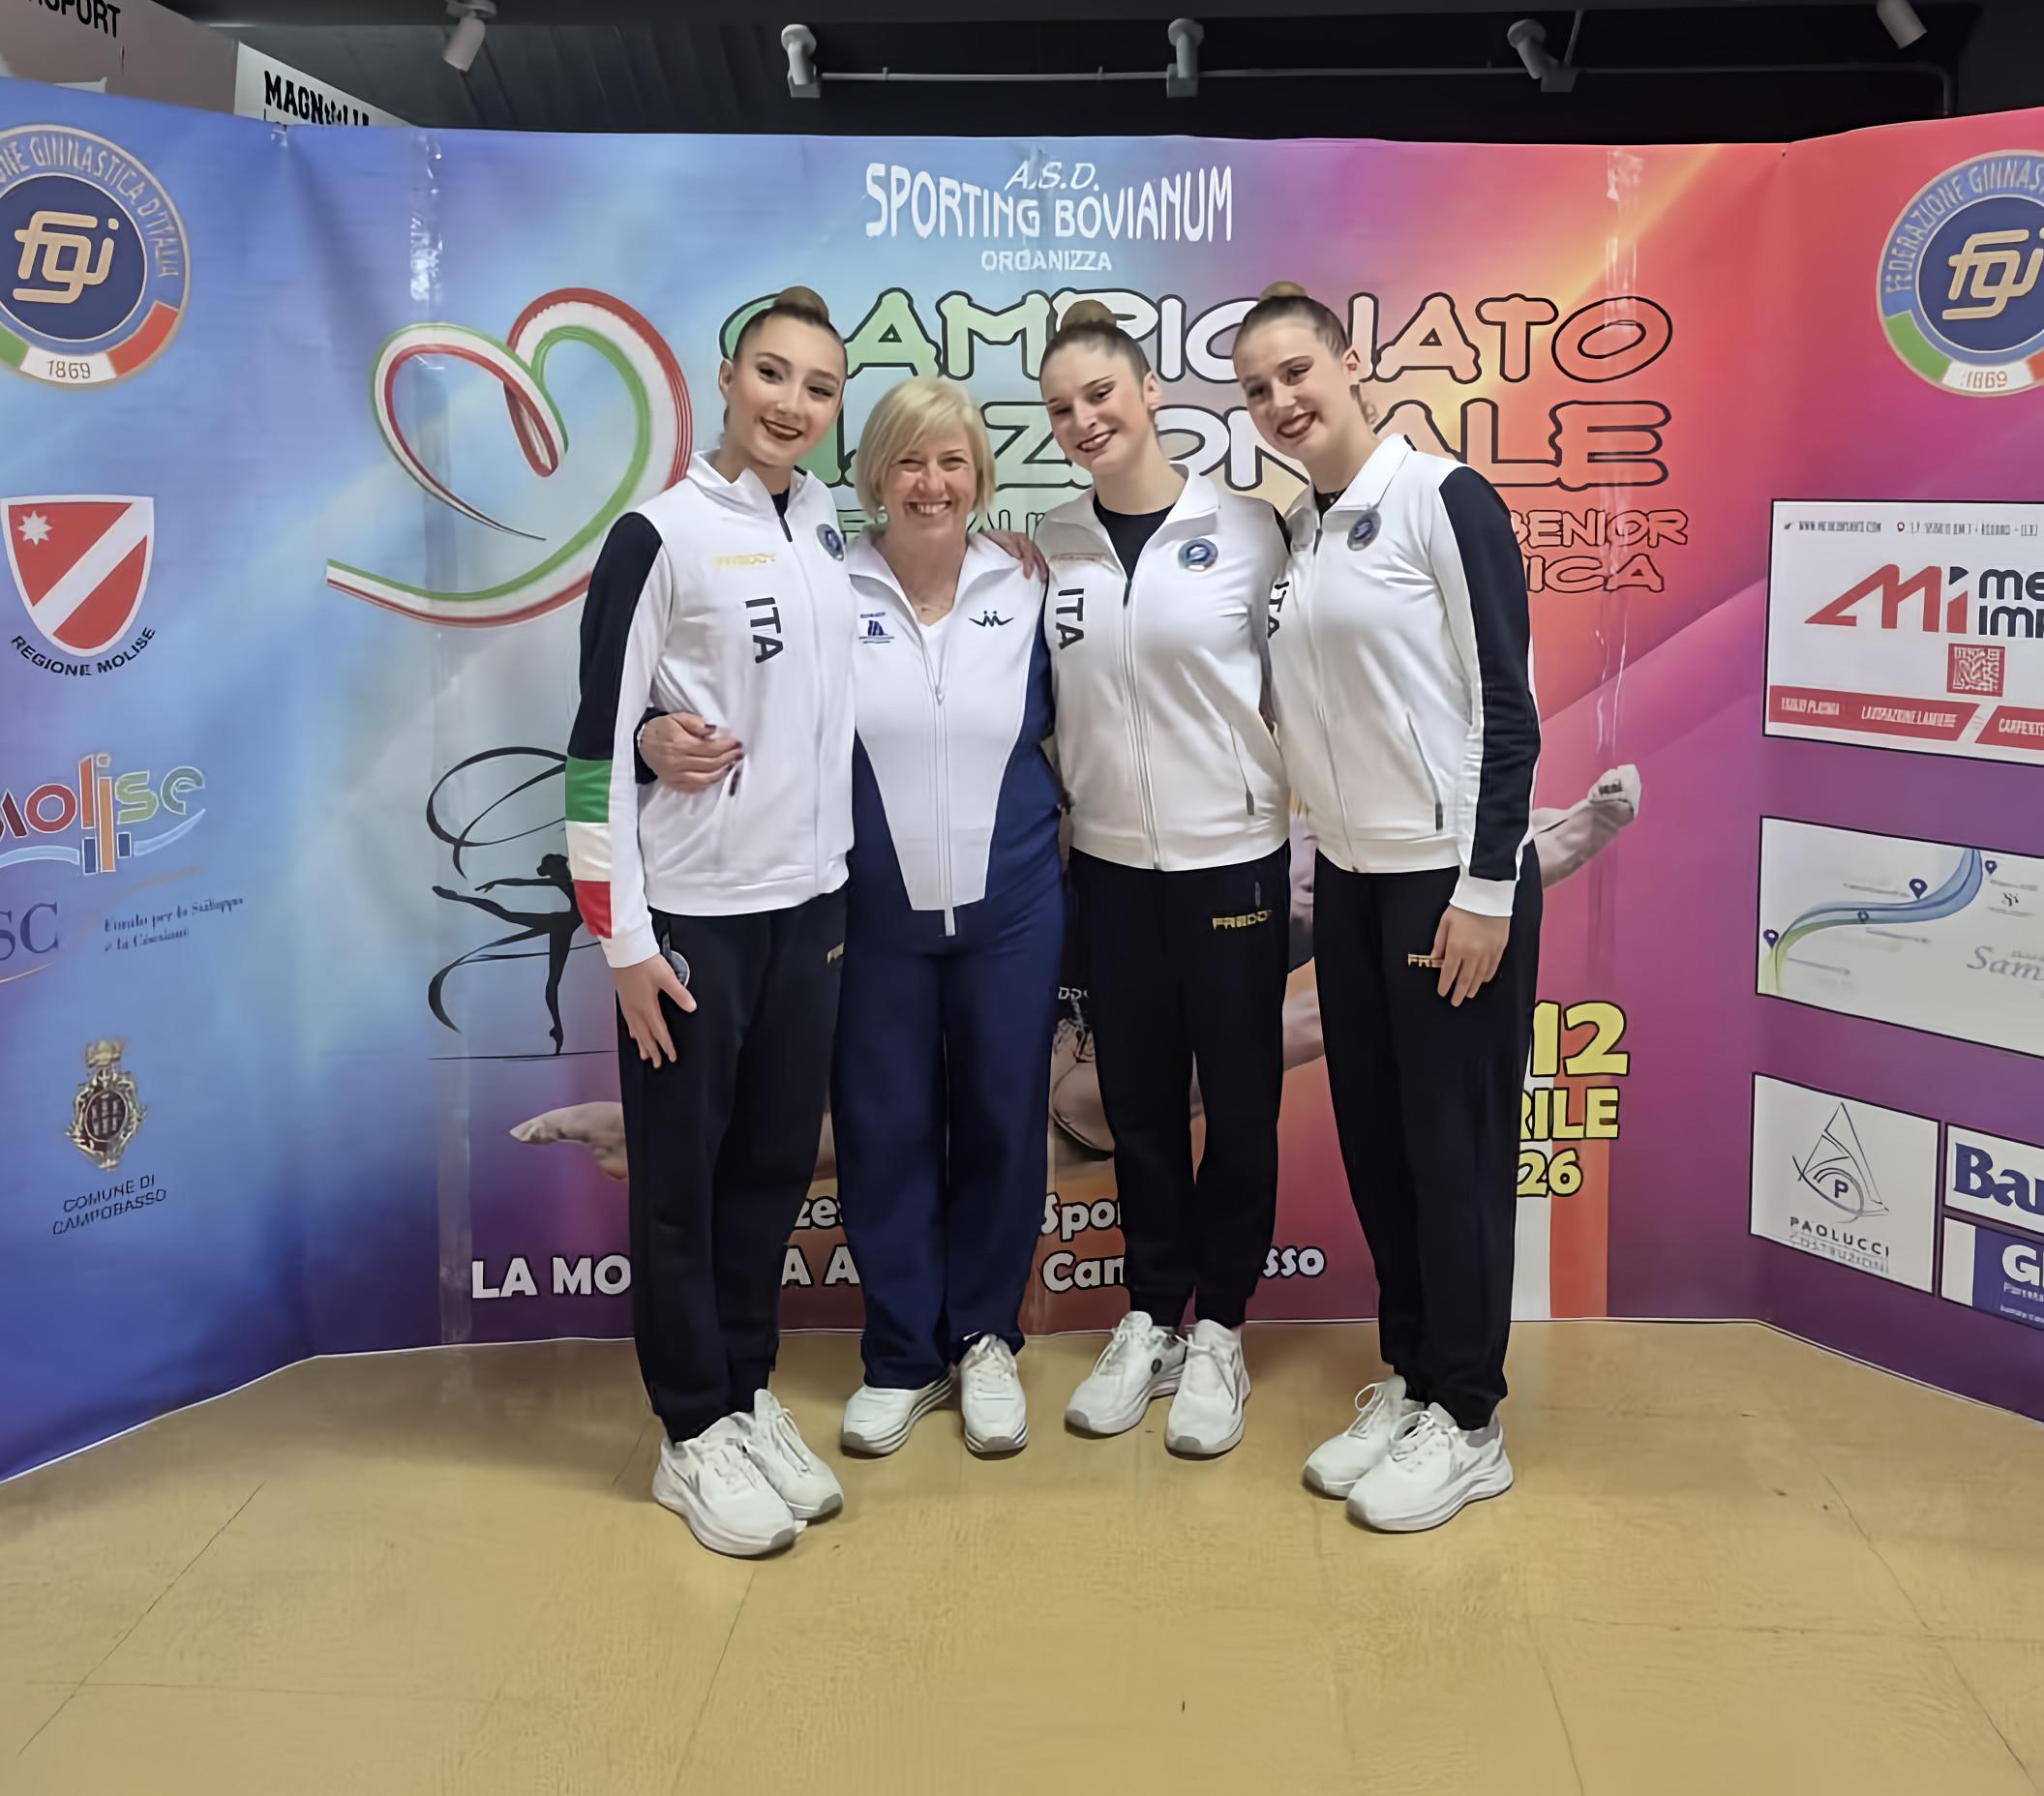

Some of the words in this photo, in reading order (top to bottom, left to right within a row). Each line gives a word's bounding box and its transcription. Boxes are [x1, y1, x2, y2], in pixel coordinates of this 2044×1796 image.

[1004, 161, 1100, 192] A.S.D.
[865, 162, 1040, 240] SPORTING
[1054, 165, 1232, 242] BOVIANUM
[980, 249, 1112, 273] ORGANIZZA
[46, 359, 92, 380] 1869
[1966, 371, 2008, 389] 1869
[744, 596, 784, 664] ITA
[1055, 587, 1085, 650] ITA
[11, 635, 93, 676] REGIONE
[97, 626, 156, 674] MOLISE
[1212, 910, 1272, 930] FREDD
[139, 1174, 155, 1189] DI
[1790, 1216, 1889, 1257] PAOLUCCI
[471, 1256, 538, 1299] LA
